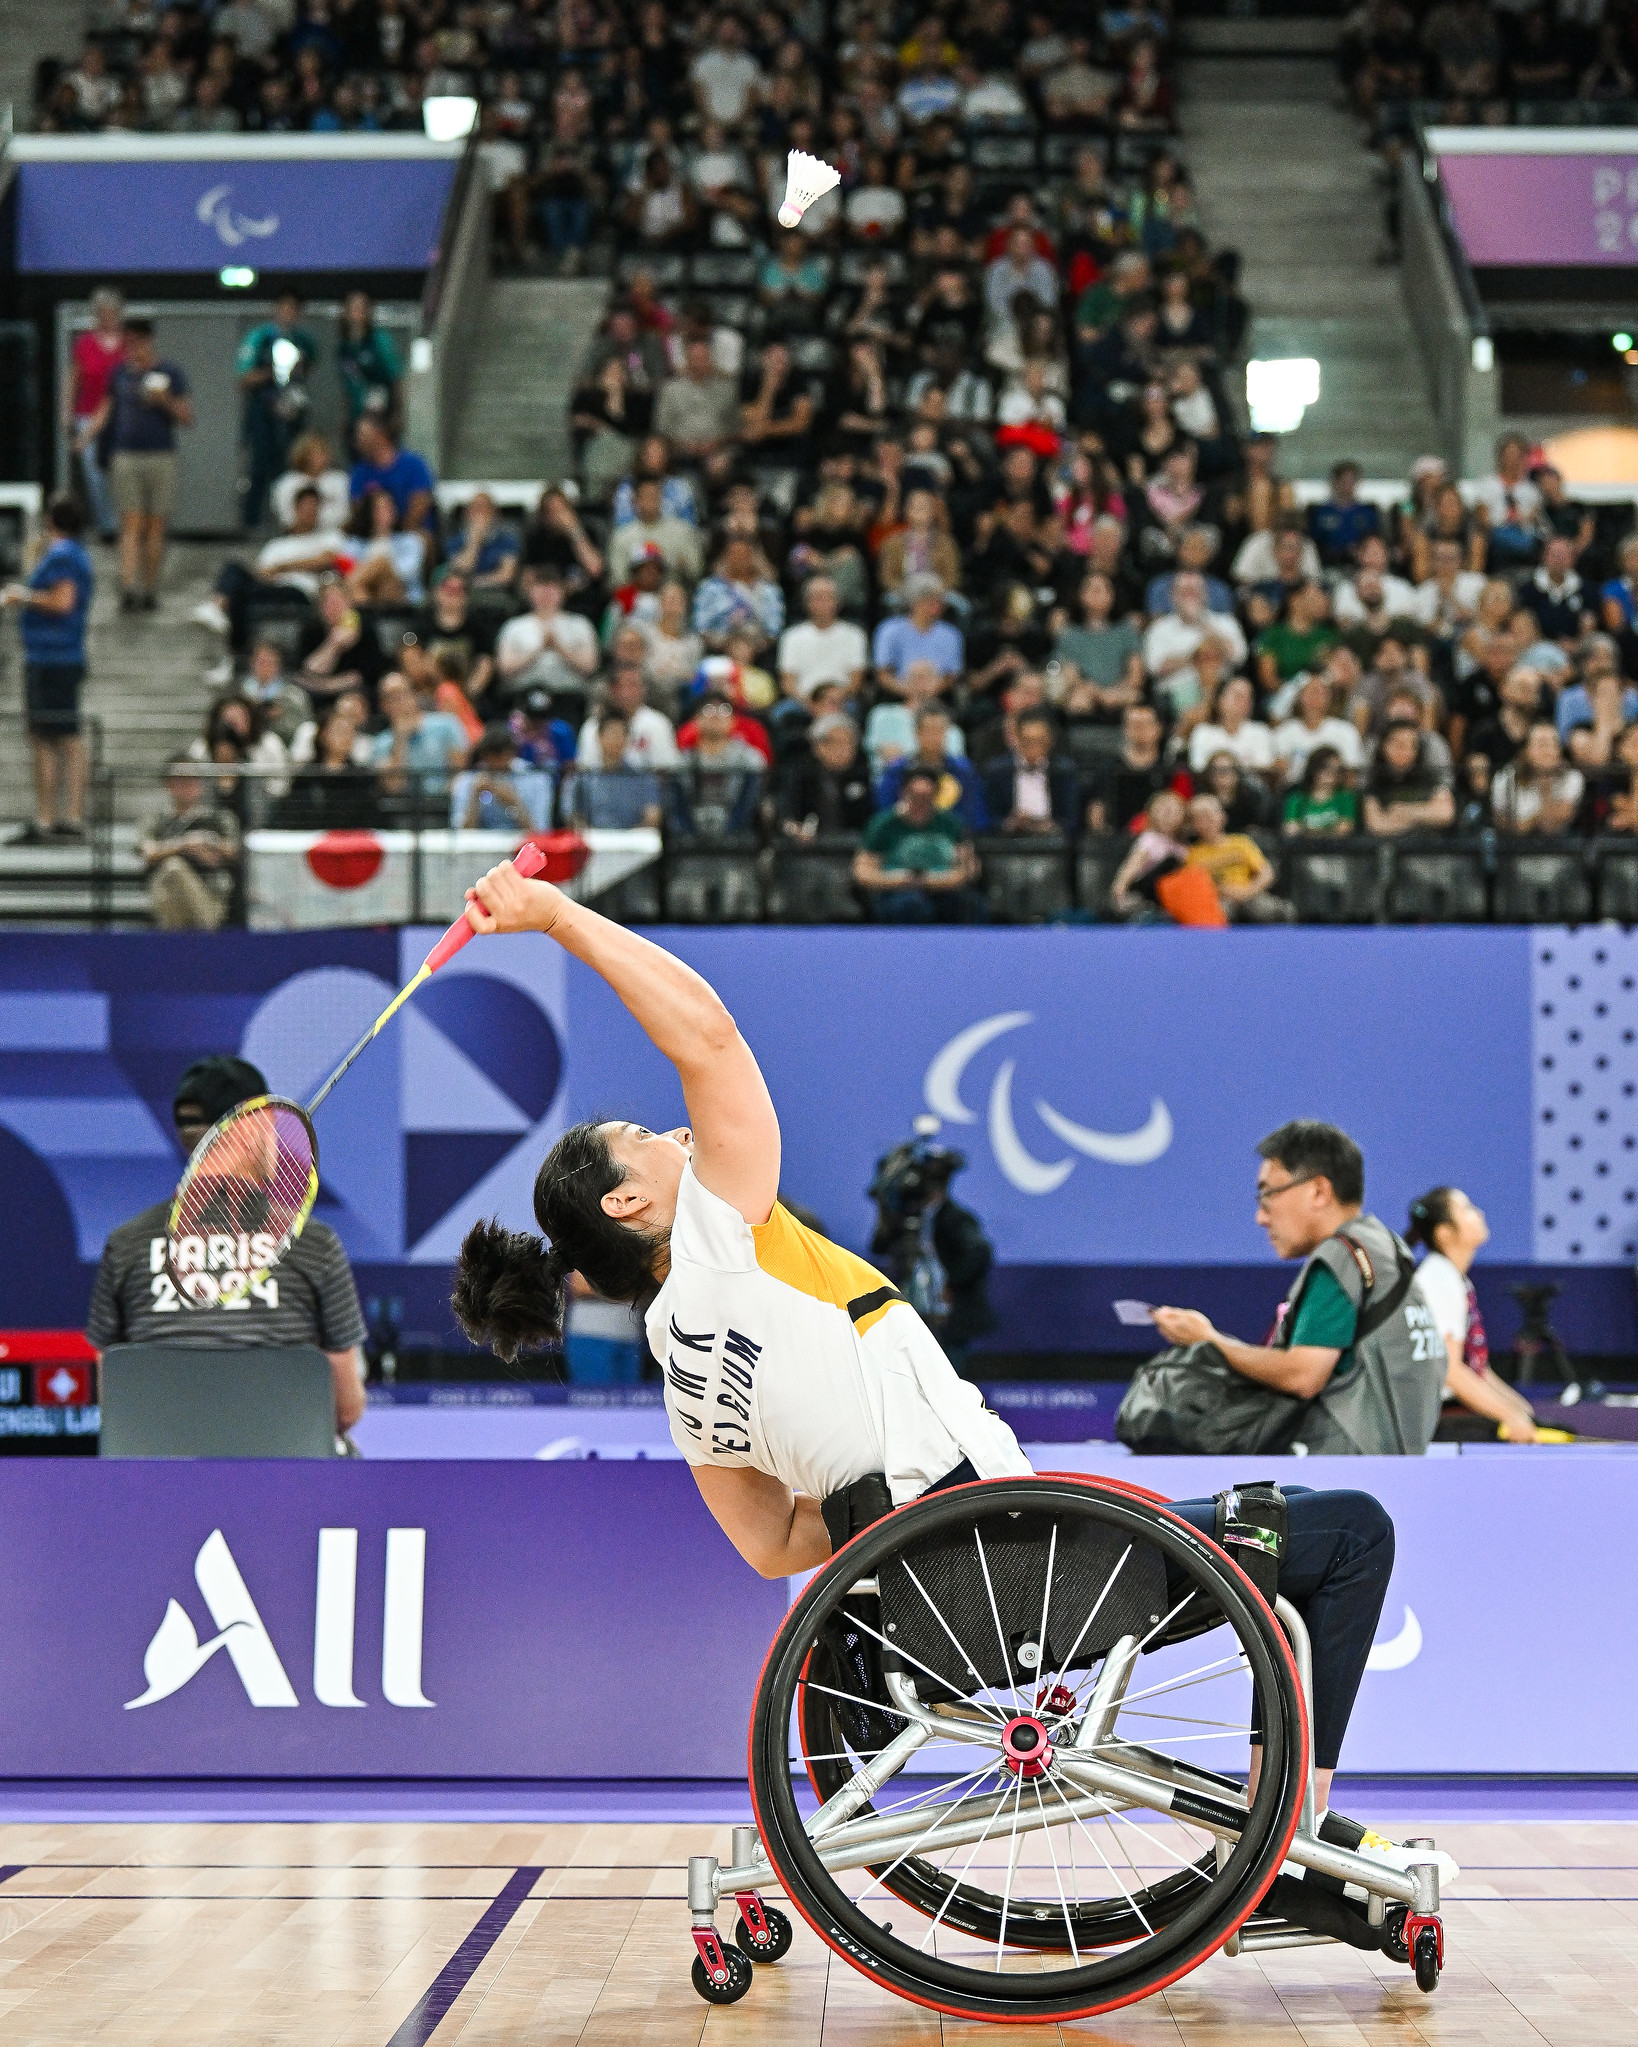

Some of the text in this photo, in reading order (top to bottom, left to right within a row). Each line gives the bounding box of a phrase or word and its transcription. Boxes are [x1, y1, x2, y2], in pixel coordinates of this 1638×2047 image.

[150, 1233, 278, 1274] PARIS
[150, 1271, 280, 1312] 2024
[830, 1927, 879, 1968] KENDA
